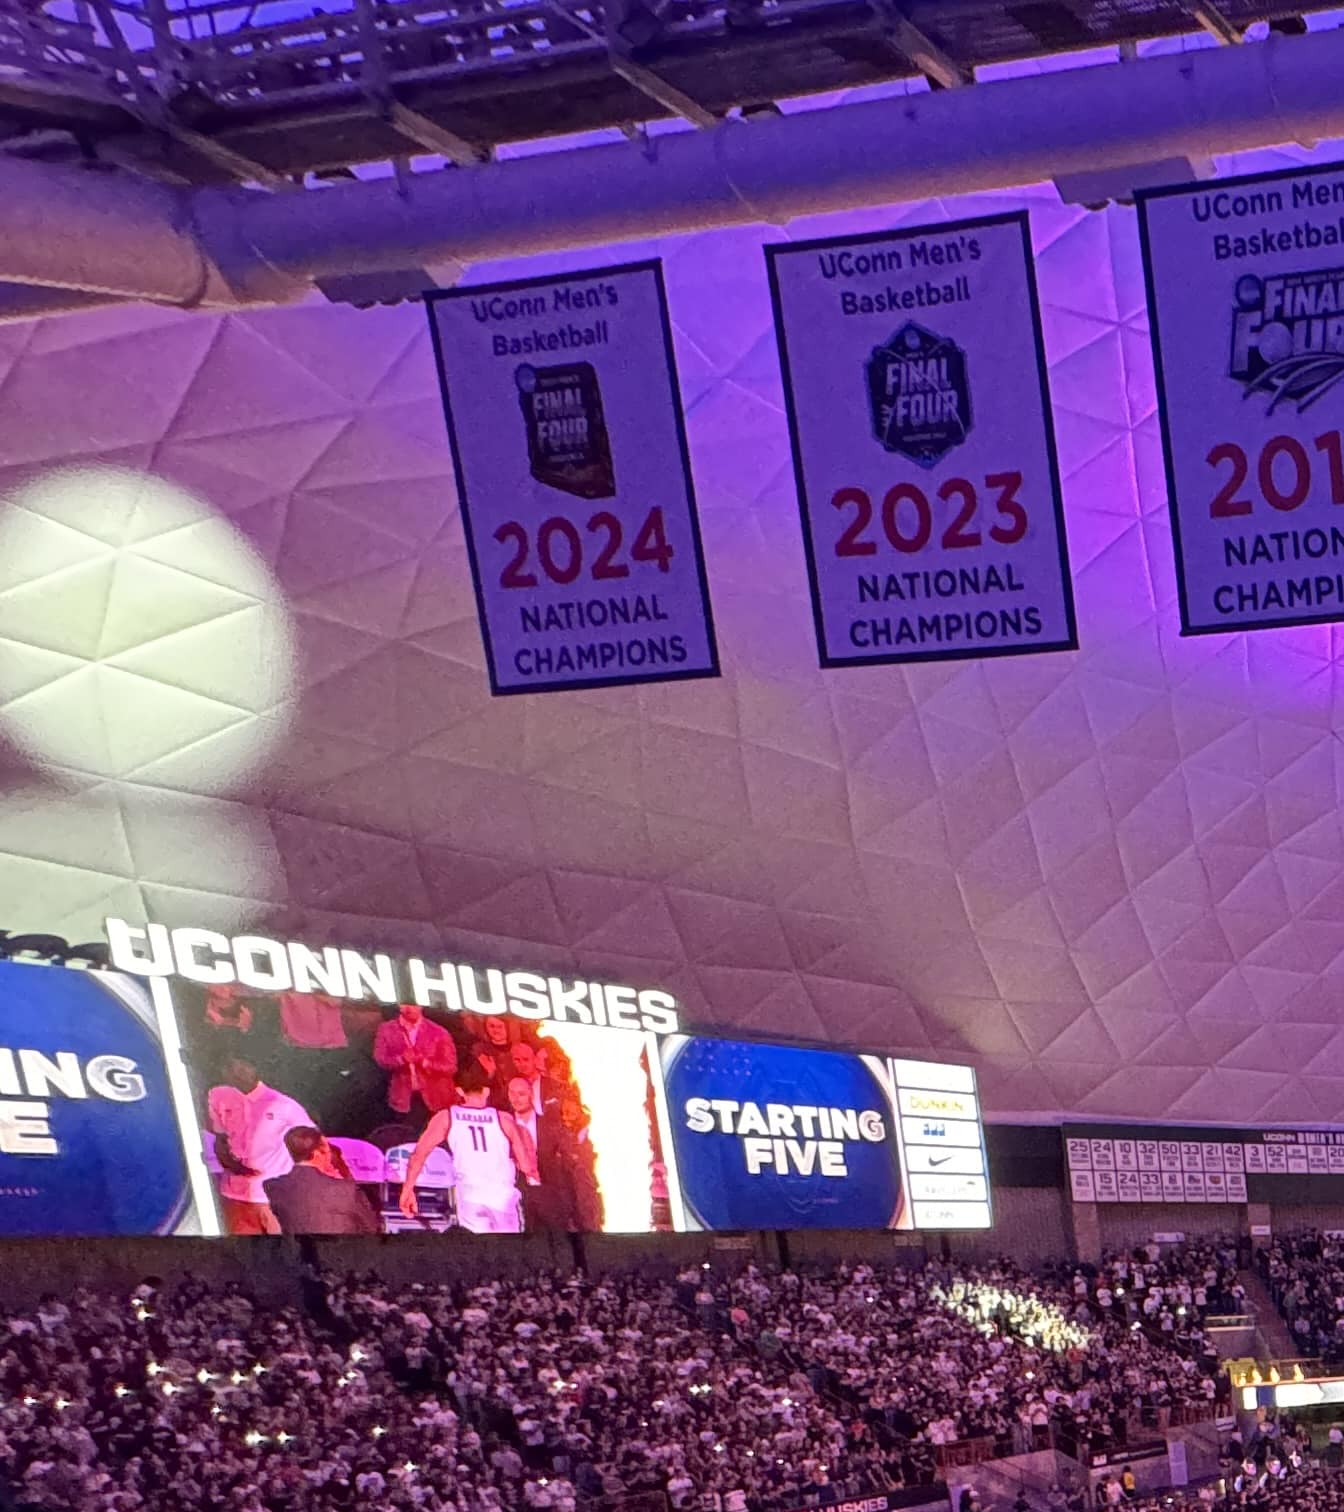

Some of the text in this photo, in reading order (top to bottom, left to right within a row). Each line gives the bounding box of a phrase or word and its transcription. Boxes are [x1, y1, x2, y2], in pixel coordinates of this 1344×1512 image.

[1192, 190, 1284, 224] UConn
[819, 236, 982, 280] UConn Men's
[472, 283, 619, 324] UConn Men's
[841, 277, 971, 316] Basketball
[492, 321, 610, 357] Basketball
[886, 357, 952, 395] FINAL
[533, 388, 586, 418] FINAL
[895, 390, 958, 426] FOUR
[537, 416, 590, 452] FOUR
[831, 471, 1028, 556] 2023
[494, 506, 673, 589] 2024
[857, 563, 1024, 602] NATIONAL
[520, 595, 668, 633] NATIONAL
[849, 607, 1042, 648] CHAMPIONS
[514, 635, 688, 677] CHAMPIONS
[106, 917, 679, 1034] UCONN HUSKIES
[469, 1125, 487, 1152] 11
[685, 1097, 885, 1142] STARTING
[746, 1138, 848, 1176] FIVE
[1070, 1141, 1088, 1151] 25
[1093, 1142, 1111, 1152] 24
[1141, 1143, 1155, 1153] 32
[1162, 1144, 1177, 1154] 50
[1226, 1146, 1240, 1156] 42
